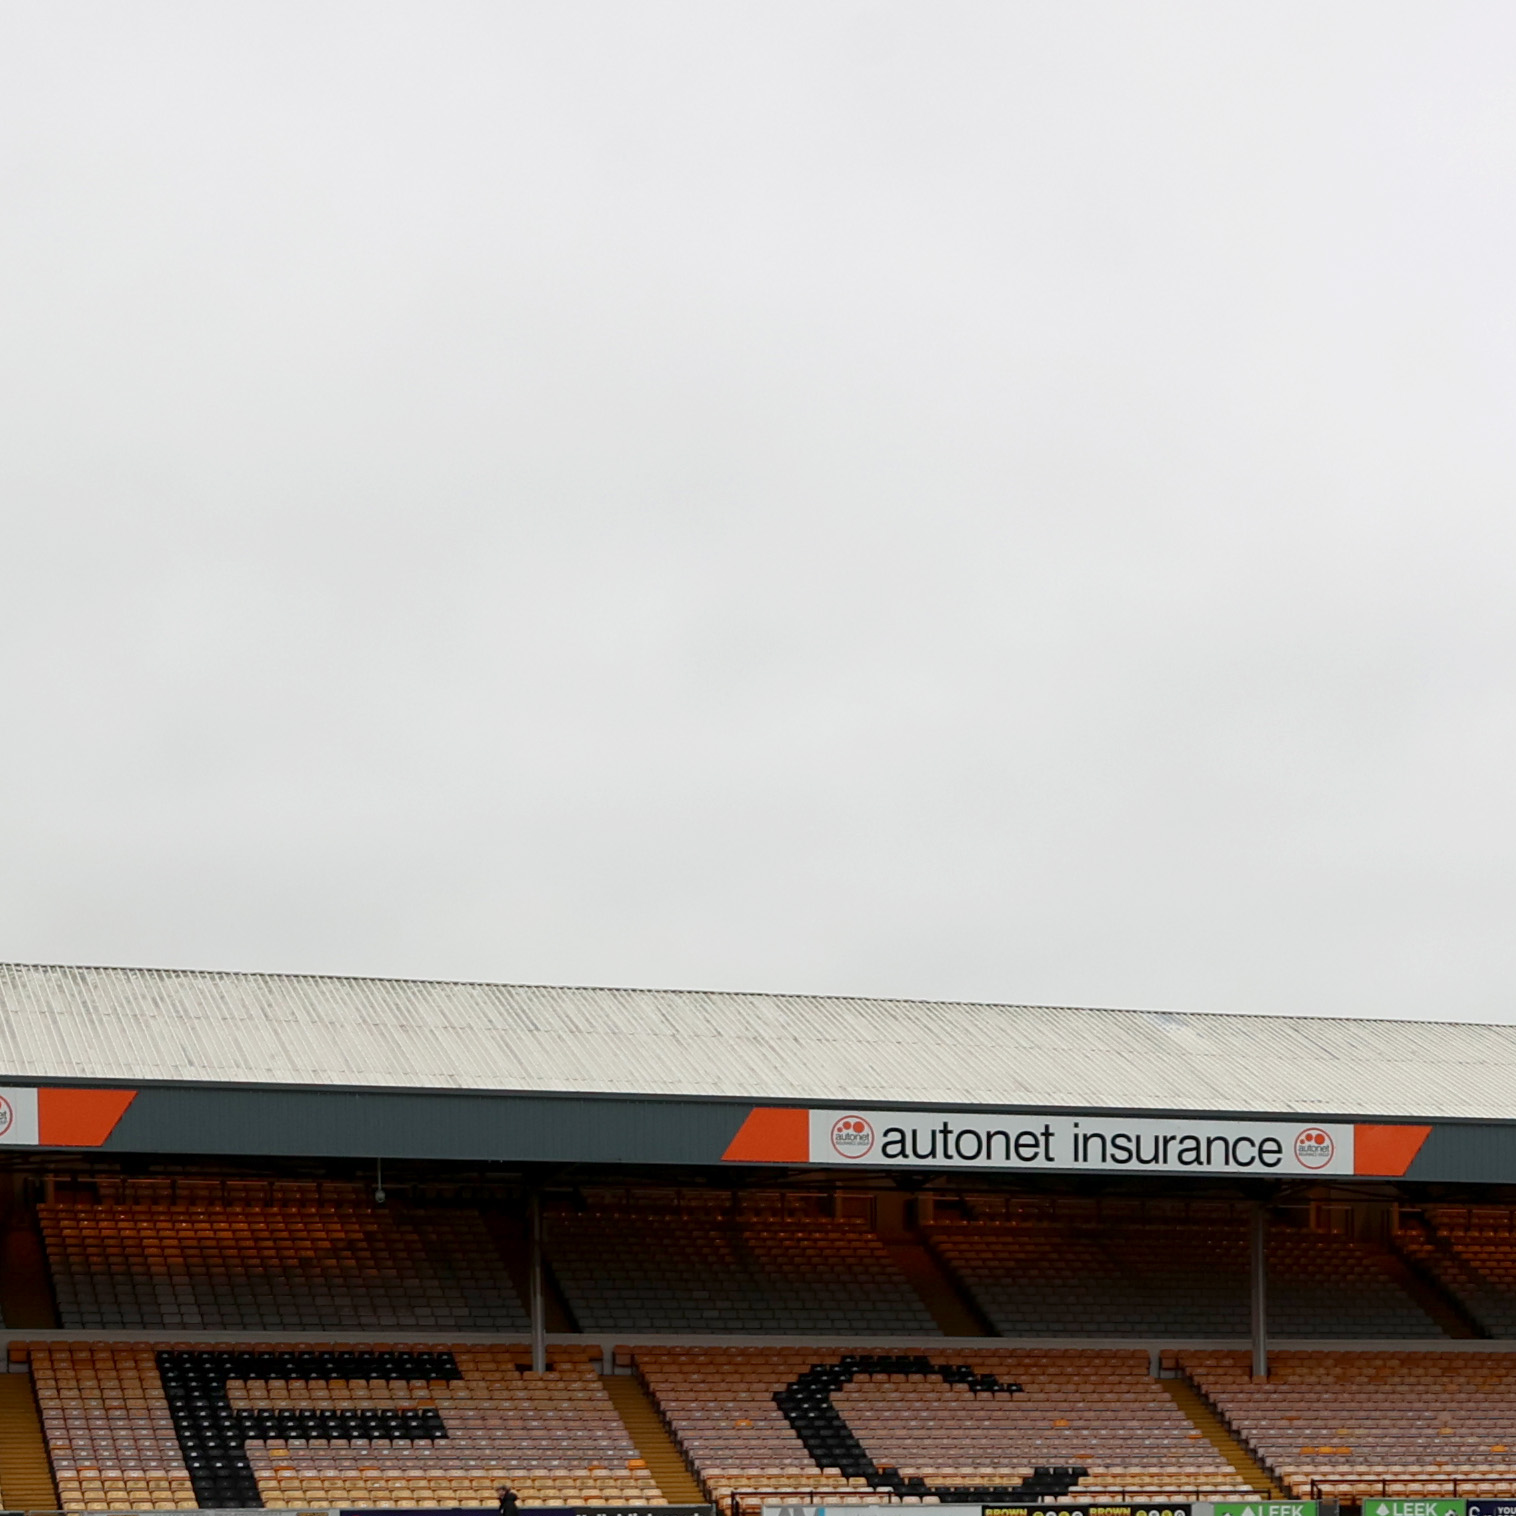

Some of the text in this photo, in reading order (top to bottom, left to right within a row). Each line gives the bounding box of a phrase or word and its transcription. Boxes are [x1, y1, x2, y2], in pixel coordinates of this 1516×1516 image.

[881, 1122, 1283, 1168] autonet insurance
[156, 1350, 464, 1508] F
[772, 1355, 1092, 1503] C
[1089, 1507, 1131, 1516] BROWN
[1393, 1503, 1437, 1516] LEEK
